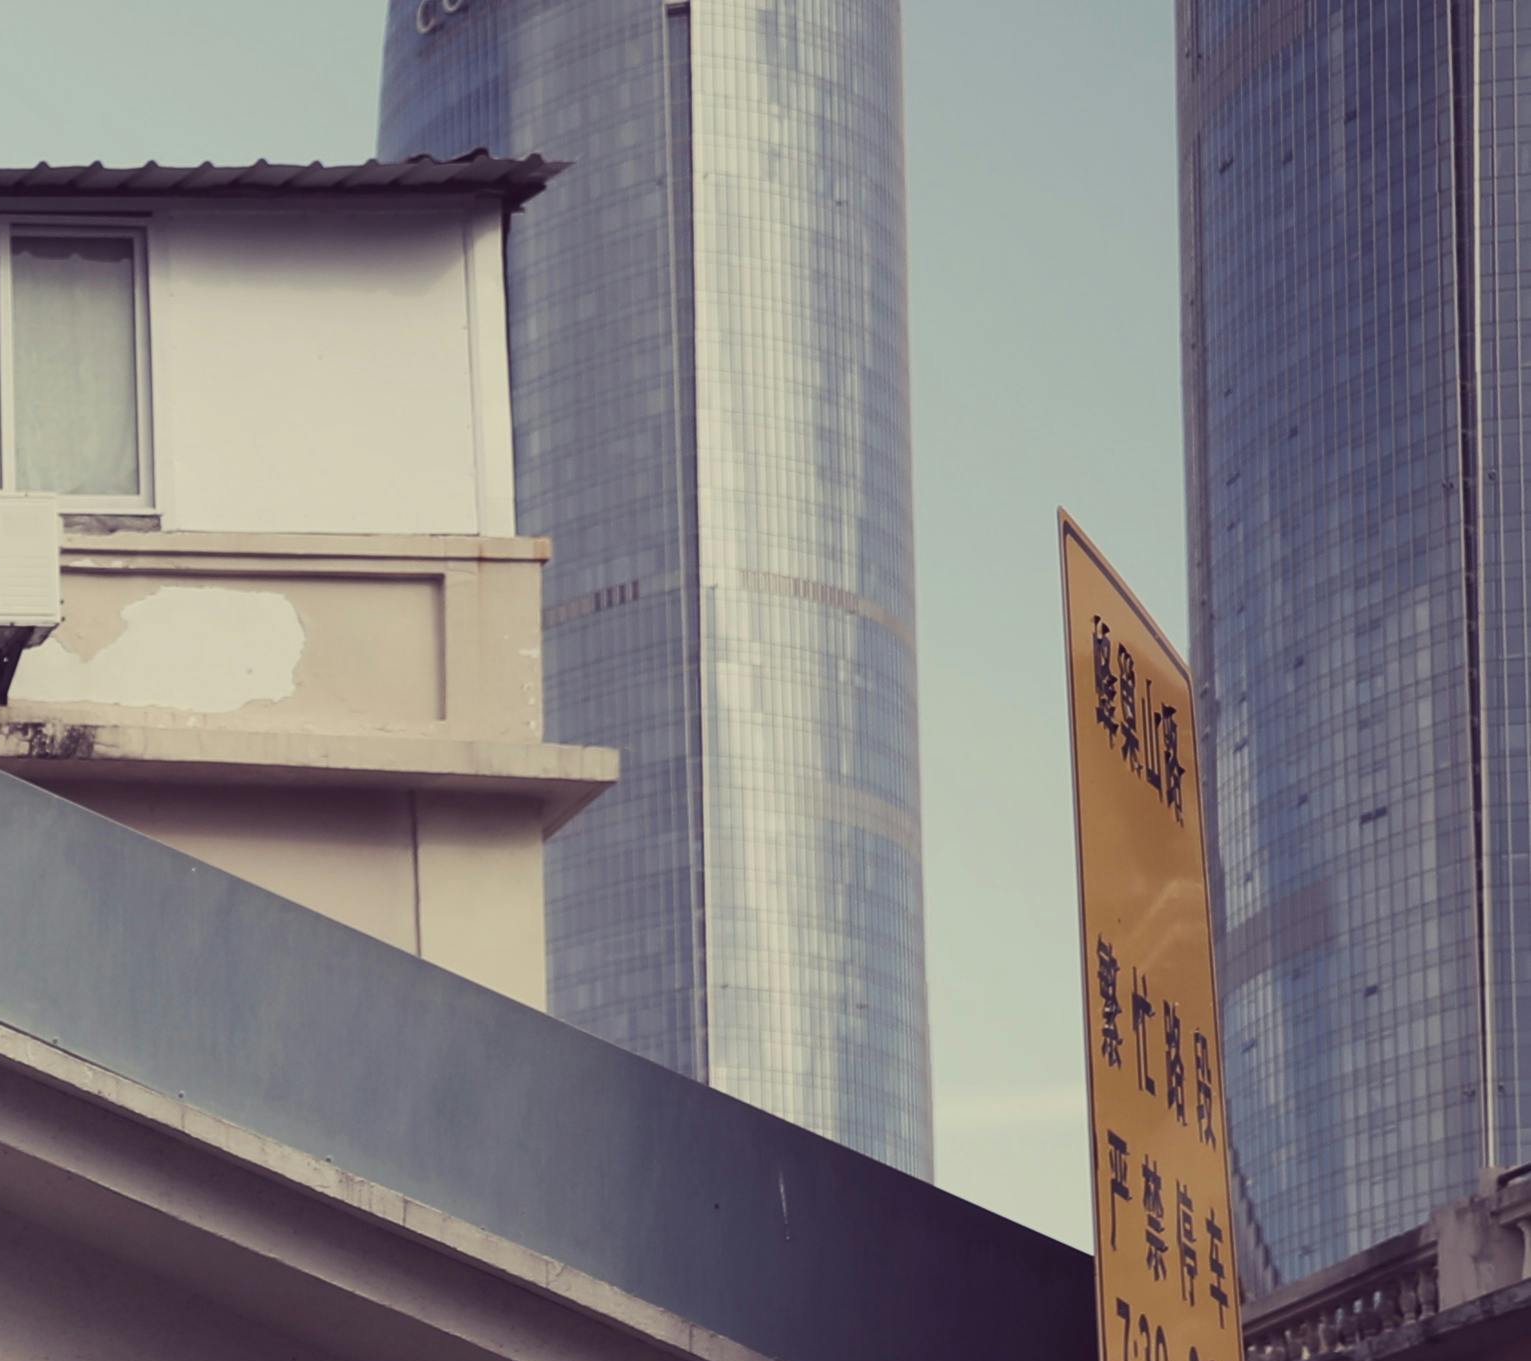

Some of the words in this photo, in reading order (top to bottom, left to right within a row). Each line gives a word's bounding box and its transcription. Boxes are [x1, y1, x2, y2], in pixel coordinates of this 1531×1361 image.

[1091, 614, 1186, 828] 蜂巢山路
[1097, 932, 1216, 1152] 繁忙路段
[1108, 1129, 1228, 1329] 严禁停车
